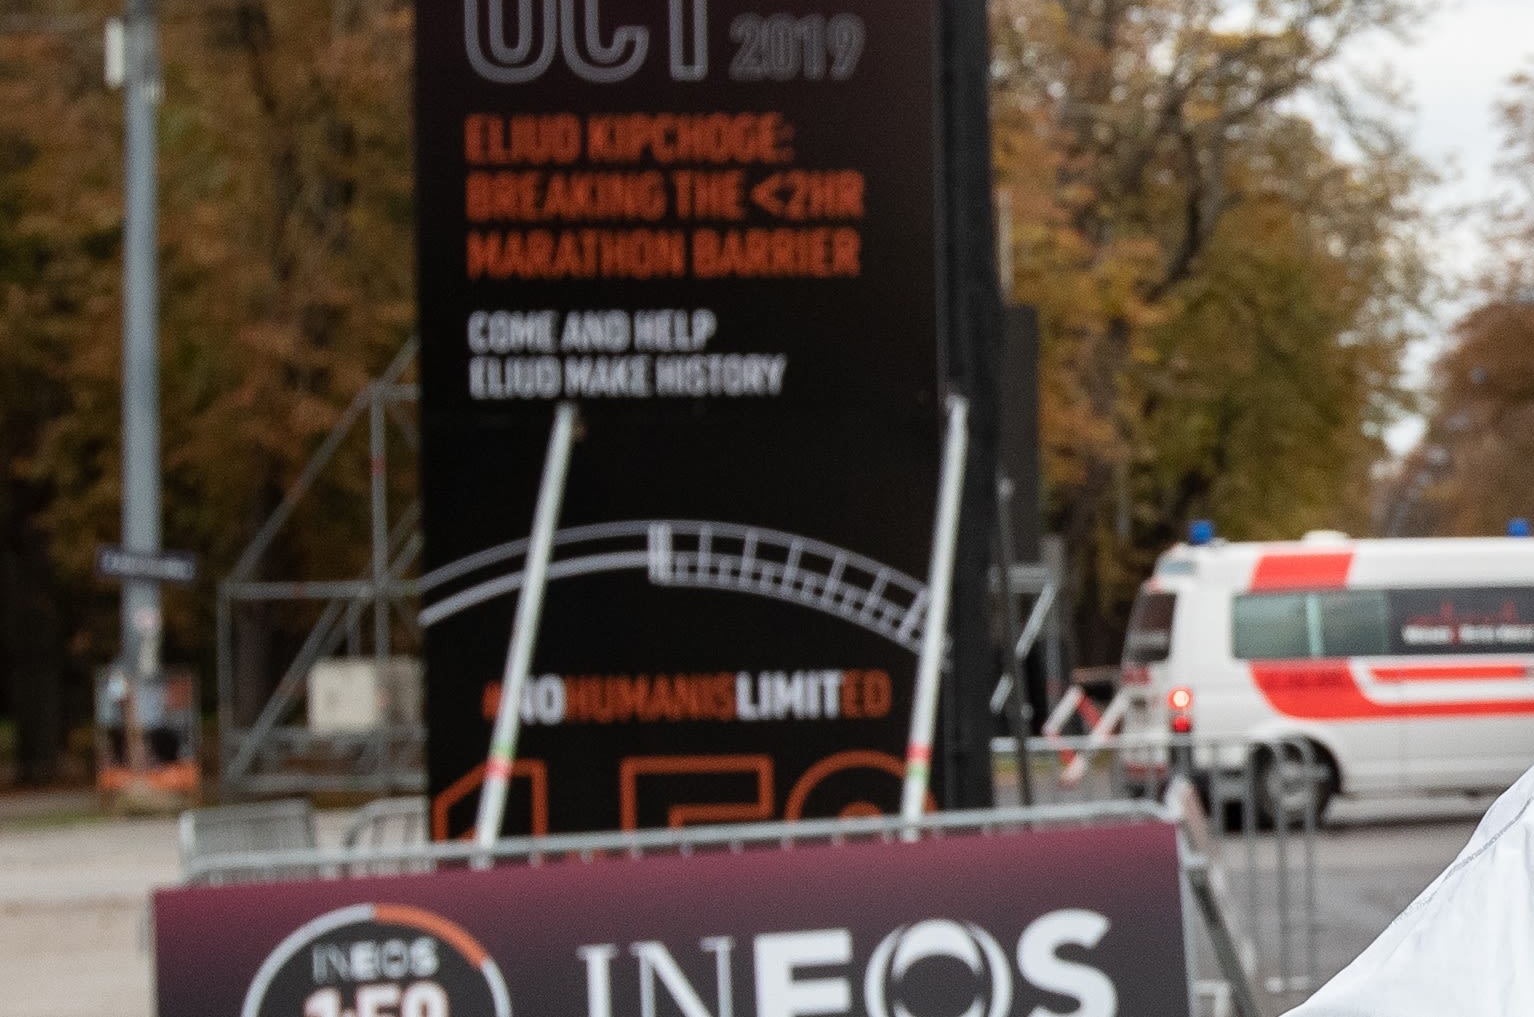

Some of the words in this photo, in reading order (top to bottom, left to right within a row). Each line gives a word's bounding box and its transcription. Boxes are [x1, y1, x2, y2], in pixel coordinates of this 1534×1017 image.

[728, 10, 866, 83] 2019
[464, 112, 582, 164] ELIUD
[587, 112, 797, 164] KIPCHOGE:
[465, 169, 667, 223] BREAKING
[673, 169, 748, 221] THE
[751, 168, 866, 222] <2HR
[466, 227, 687, 280] MARATHON
[692, 226, 863, 280] BARRIER
[467, 308, 559, 354] COME
[559, 308, 632, 353] AND
[633, 307, 718, 353] HELP
[469, 354, 564, 400] ELIUD
[563, 353, 653, 399] MAKE
[654, 351, 788, 398] HISTORY
[311, 935, 440, 984] INEOS
